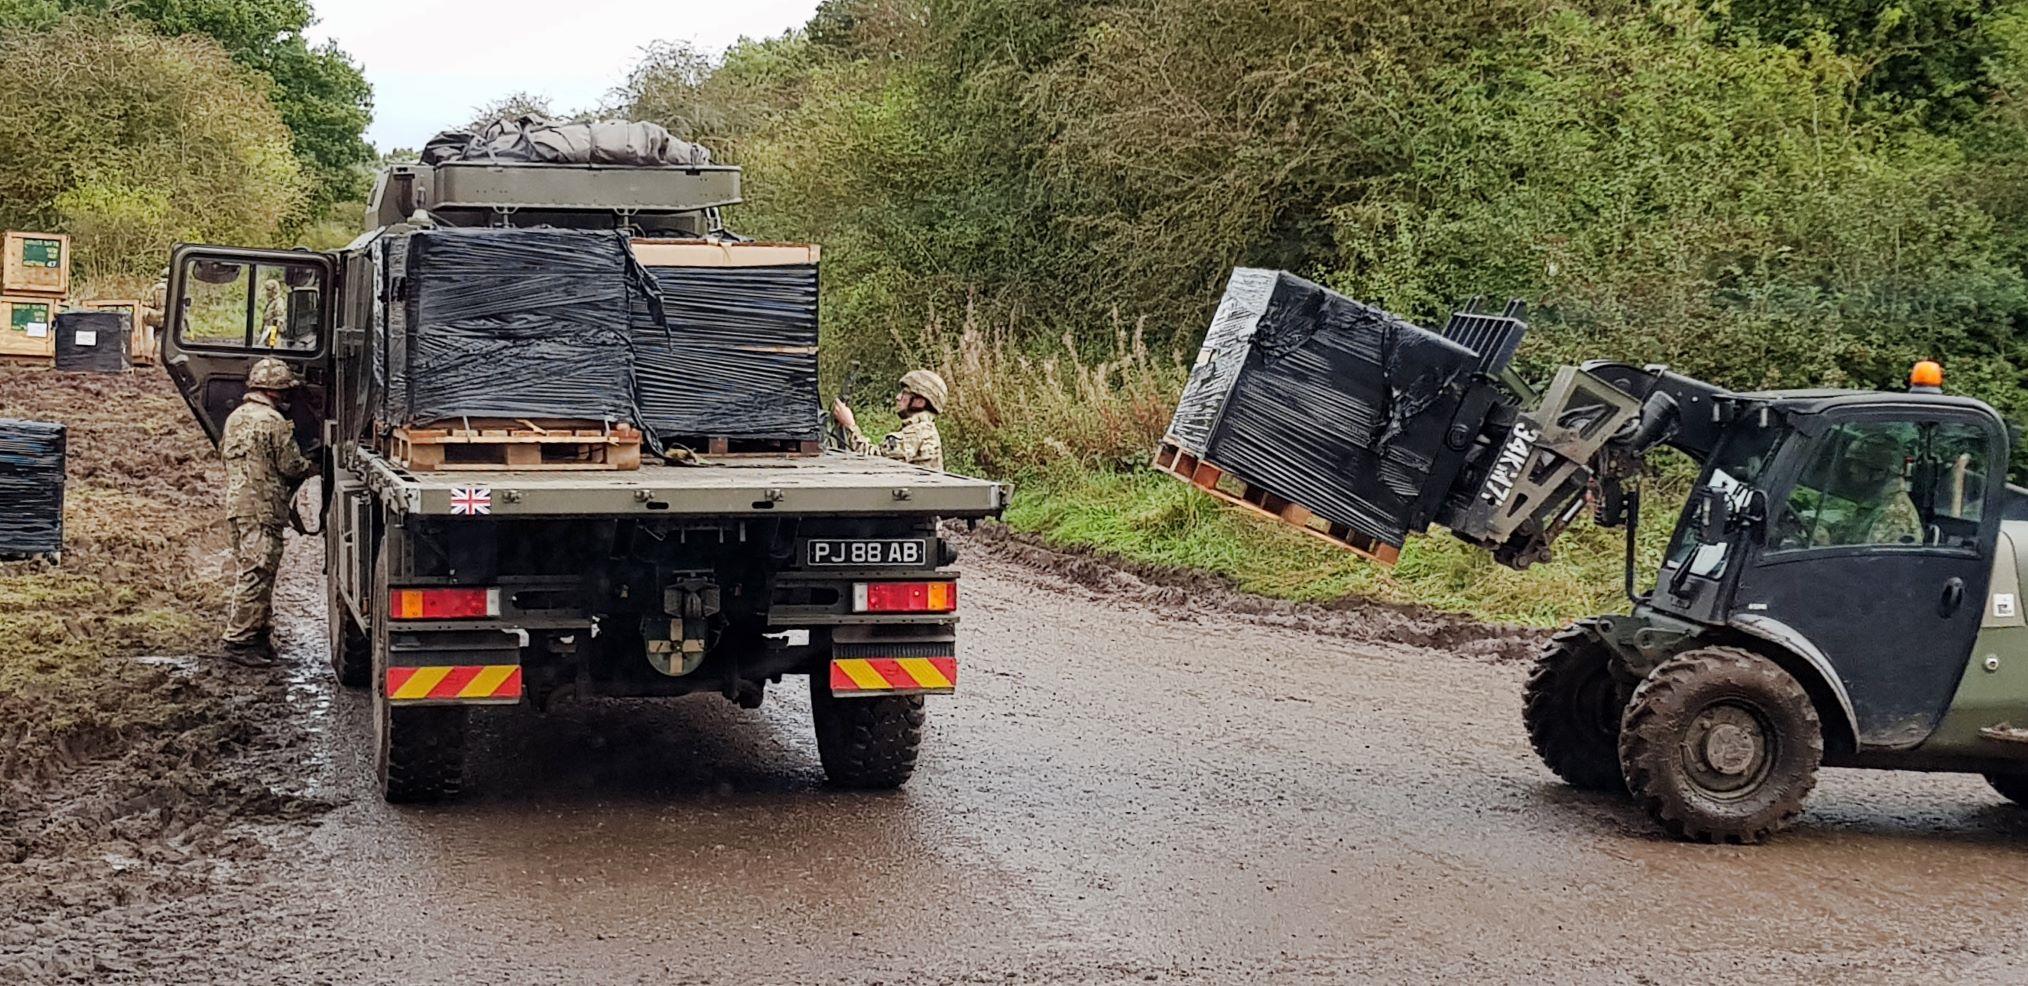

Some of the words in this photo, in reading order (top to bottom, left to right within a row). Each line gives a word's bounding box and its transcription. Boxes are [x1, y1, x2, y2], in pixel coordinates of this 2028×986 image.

[815, 542, 846, 562] PJ
[851, 542, 882, 562] 88
[888, 542, 918, 562] AB
